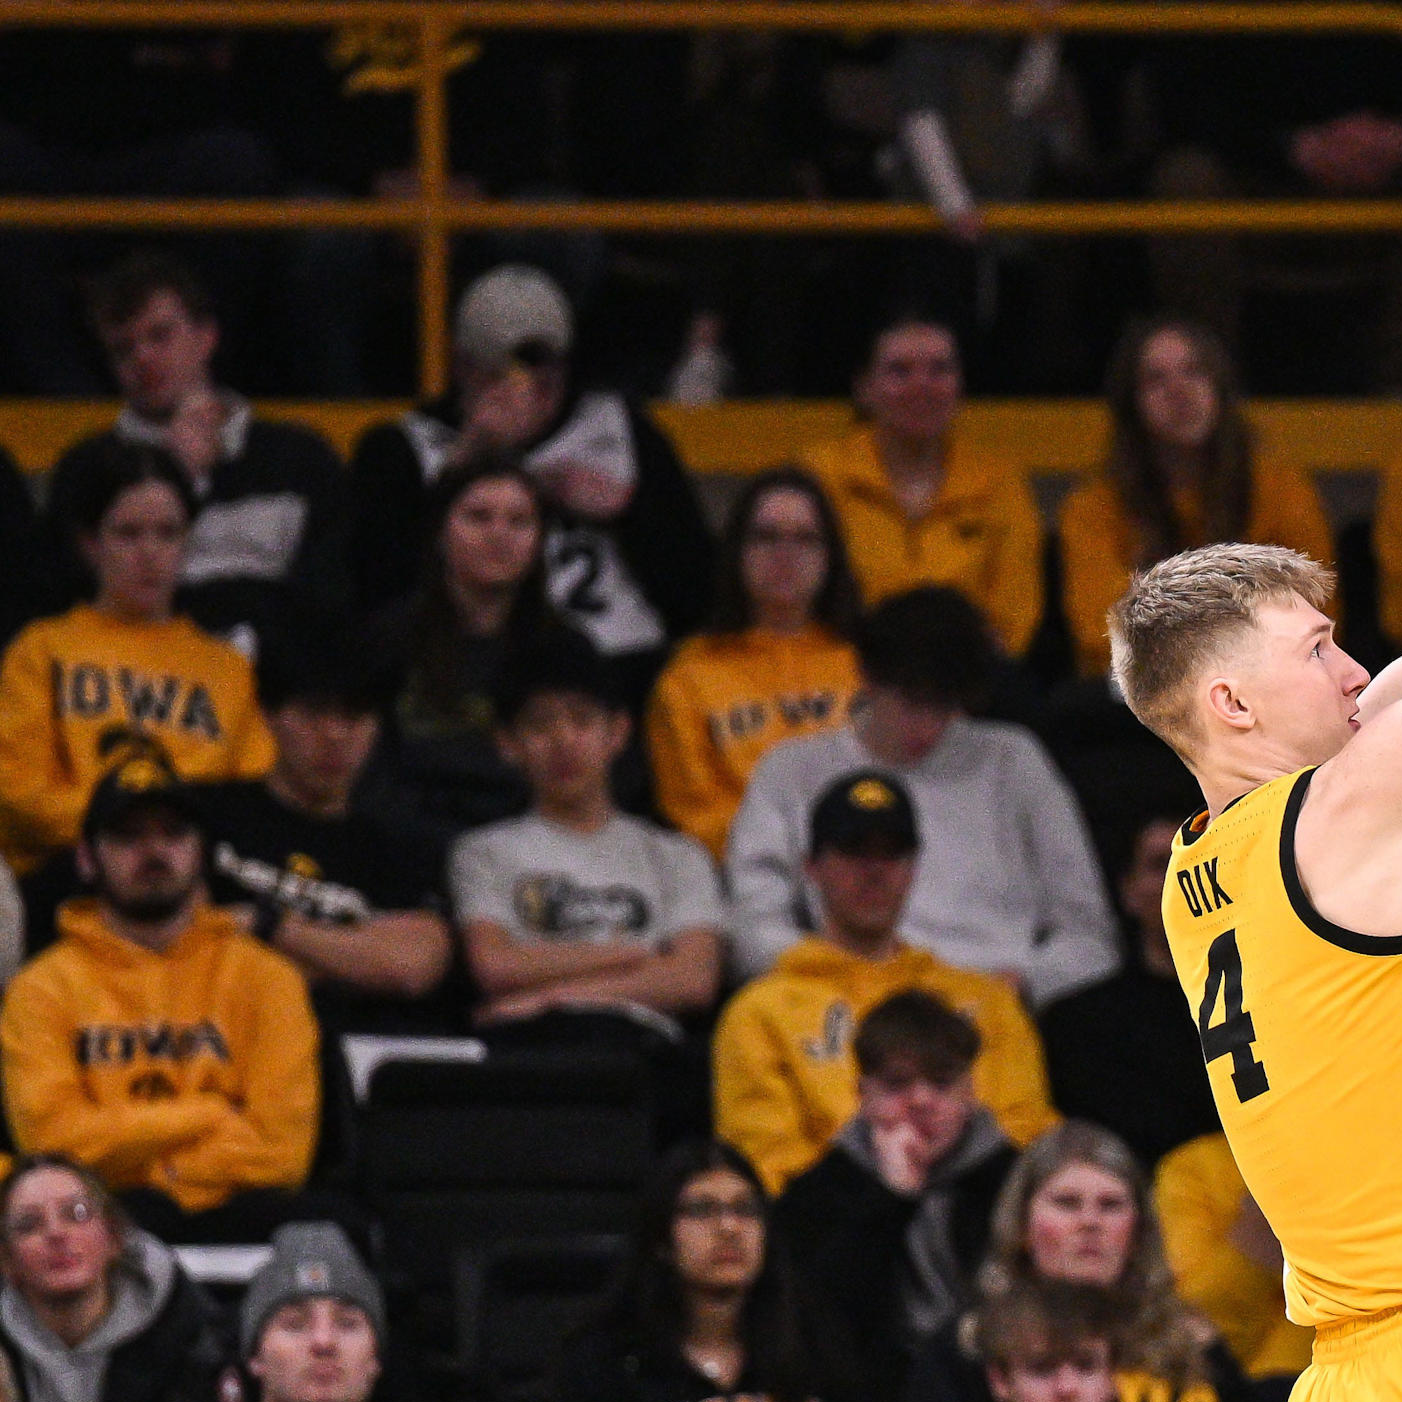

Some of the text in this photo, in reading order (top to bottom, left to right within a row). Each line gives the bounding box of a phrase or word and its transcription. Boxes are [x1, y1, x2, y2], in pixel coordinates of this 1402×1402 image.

[49, 655, 222, 740] IOWA
[74, 1017, 232, 1068] IOWA
[1198, 928, 1270, 1104] 4
